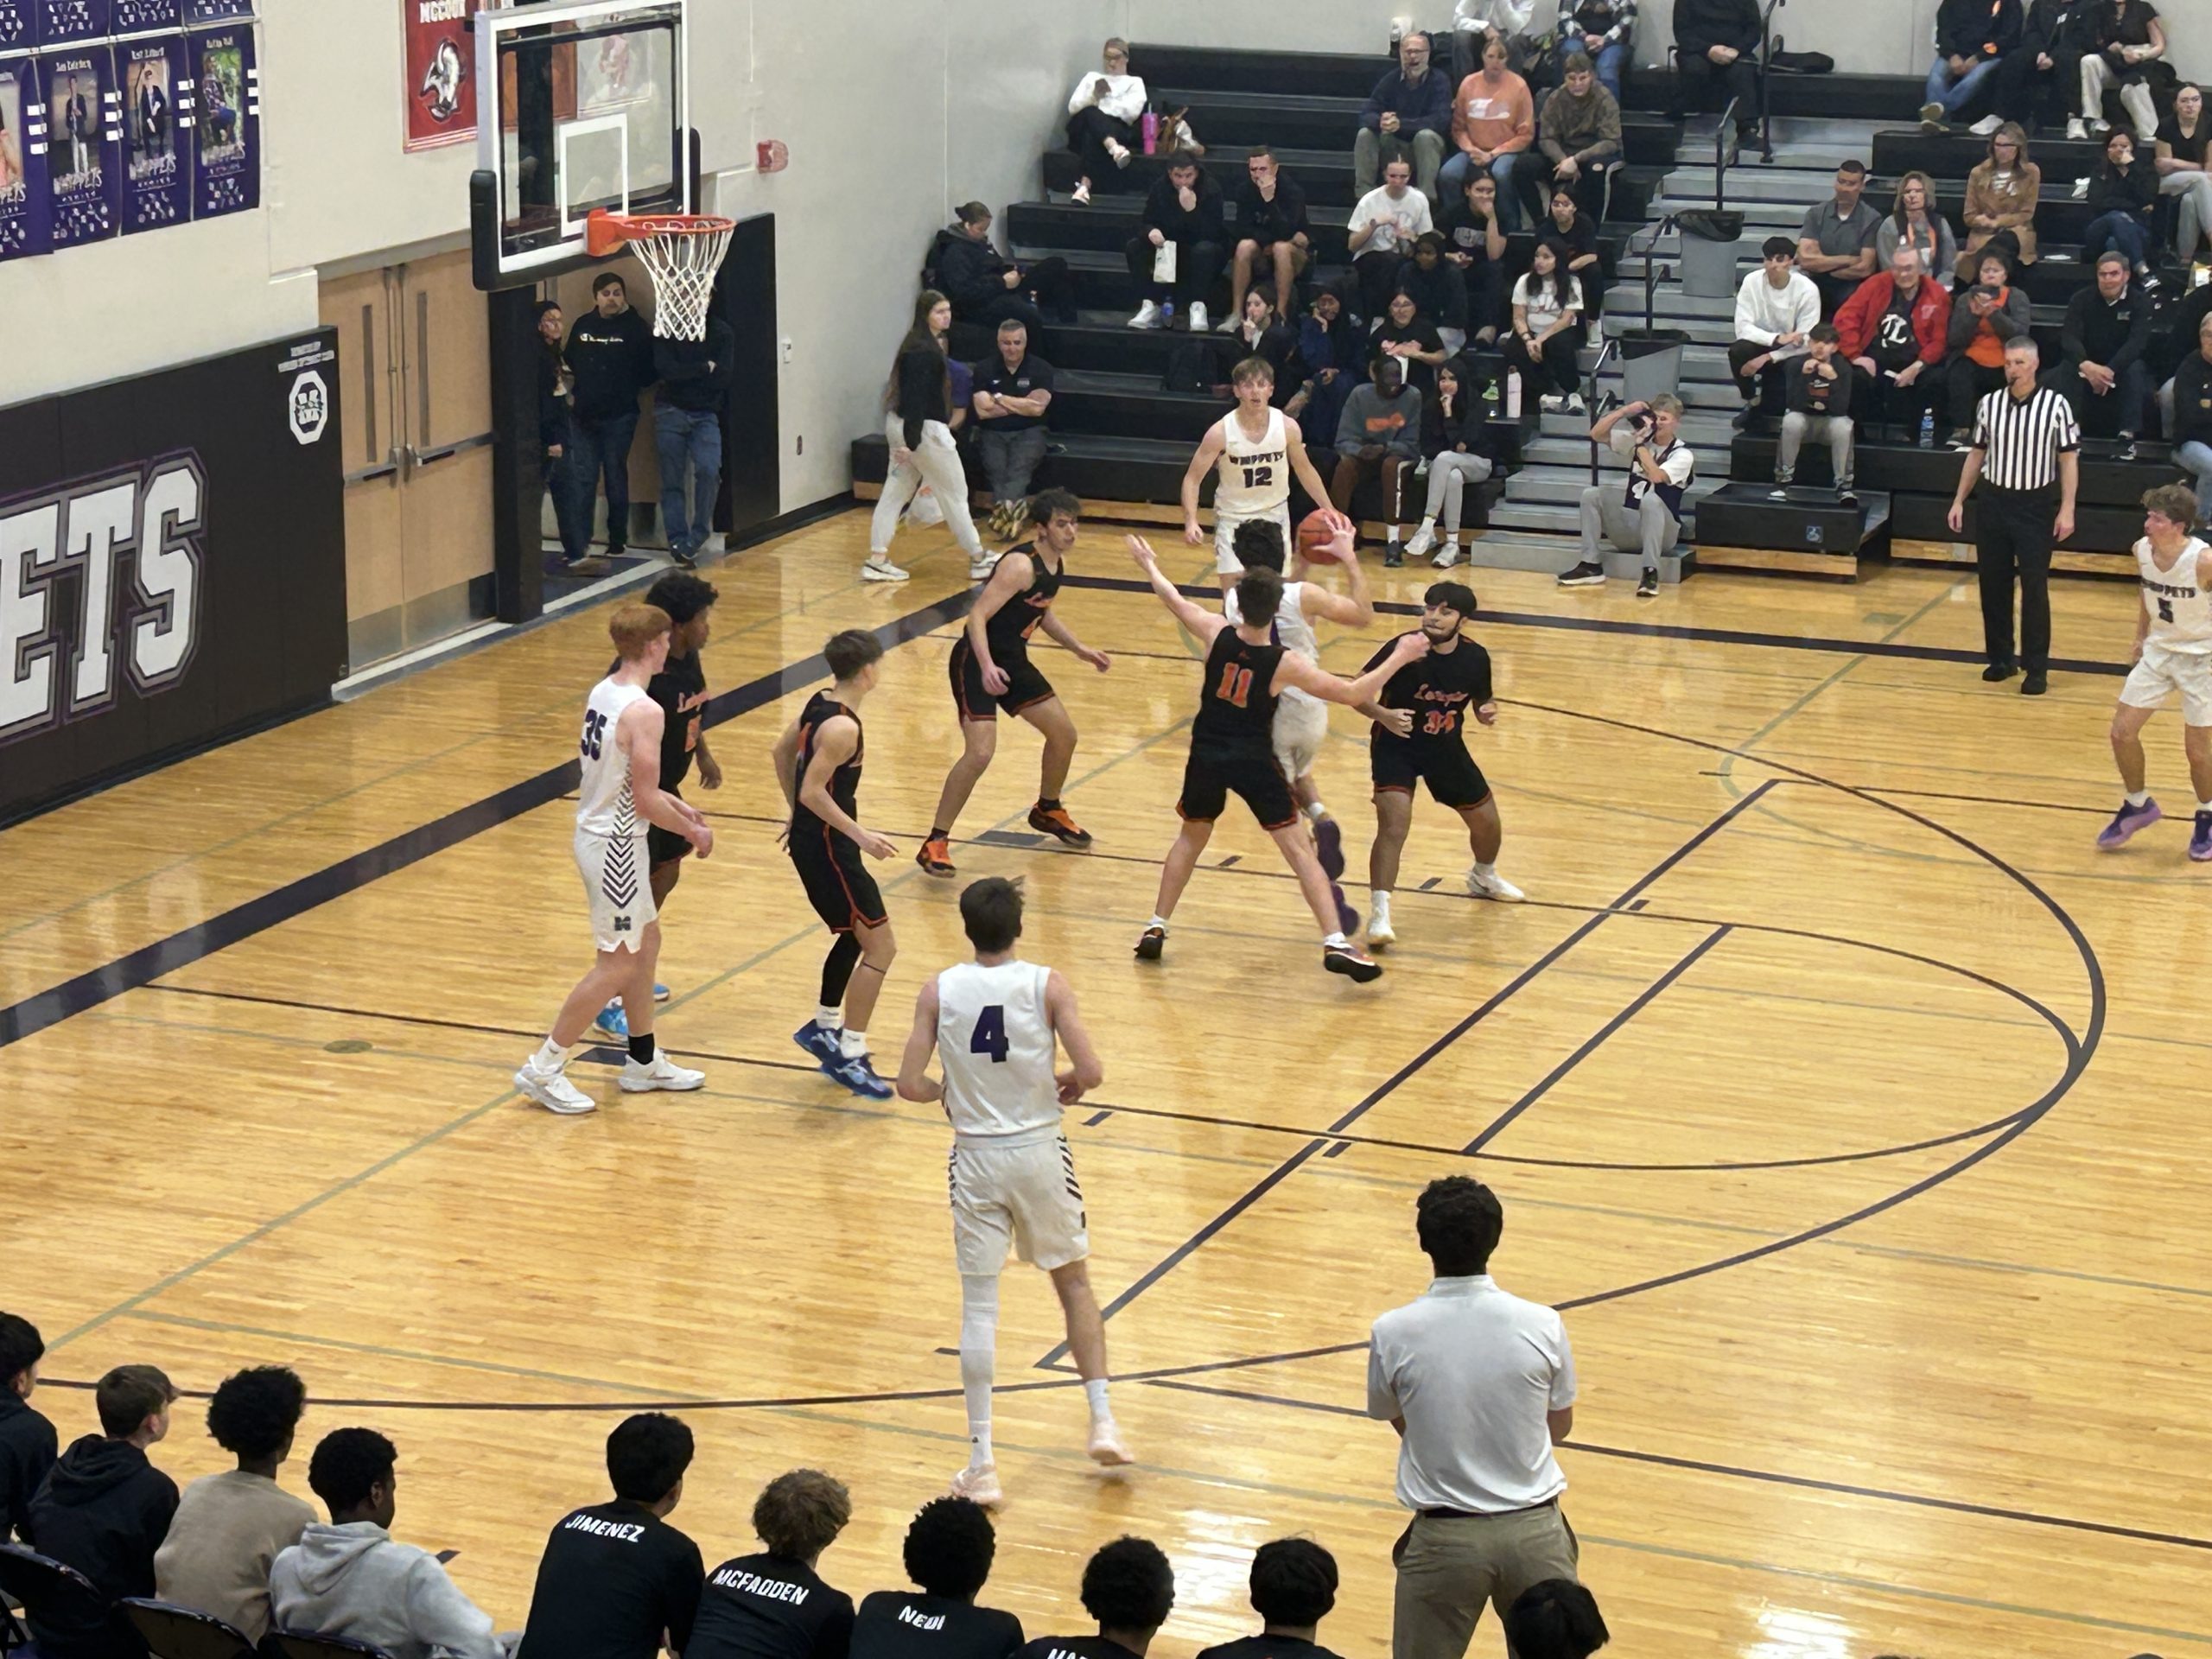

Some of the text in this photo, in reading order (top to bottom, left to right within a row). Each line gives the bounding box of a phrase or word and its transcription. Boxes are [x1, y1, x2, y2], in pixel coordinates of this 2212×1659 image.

[1243, 466, 1273, 488] 12
[2158, 597, 2174, 623] 5
[1216, 662, 1254, 709] 11
[581, 709, 608, 761] 35
[970, 1005, 1009, 1064] 4
[564, 1514, 645, 1543] JIMENEZ
[711, 1568, 810, 1605] MCFADDEN
[1046, 1648, 1088, 1659] MA
